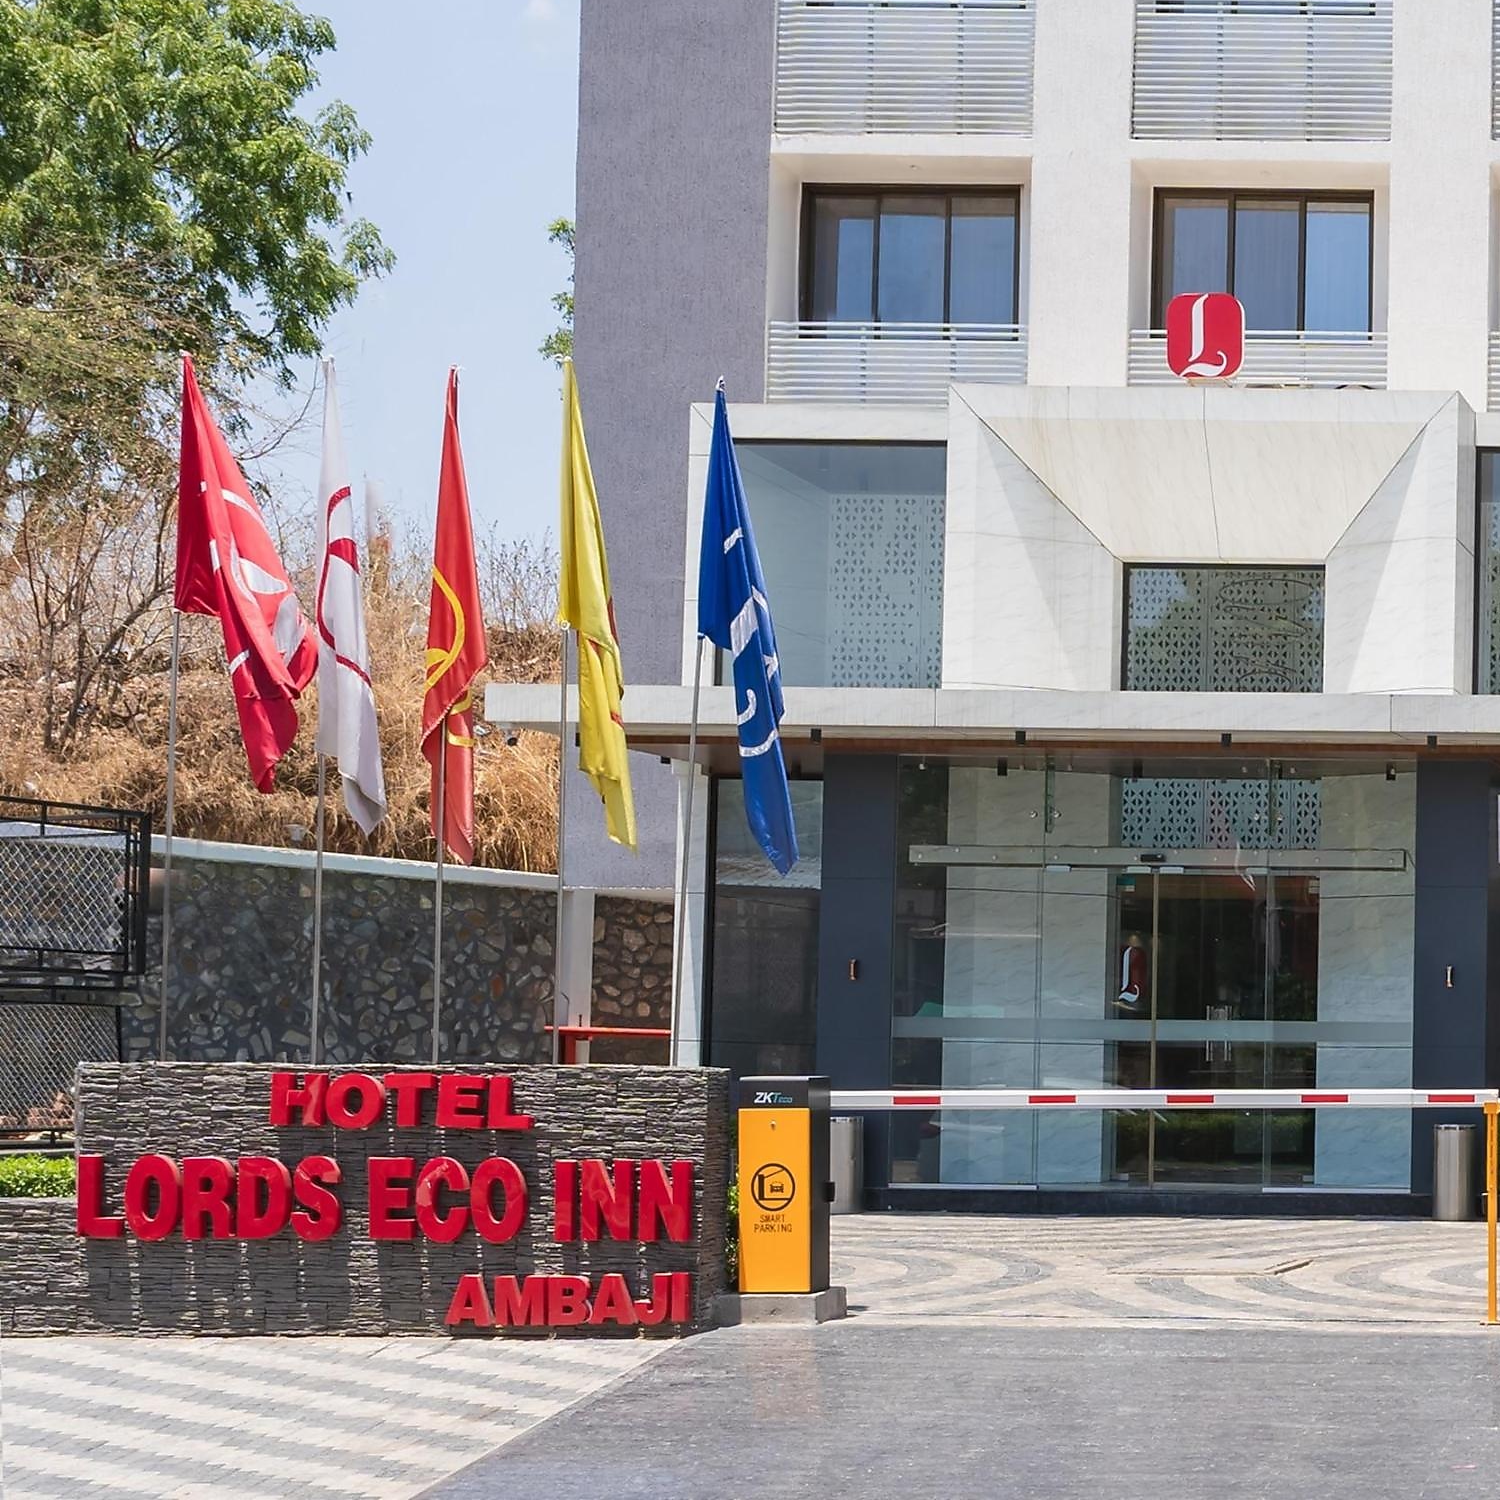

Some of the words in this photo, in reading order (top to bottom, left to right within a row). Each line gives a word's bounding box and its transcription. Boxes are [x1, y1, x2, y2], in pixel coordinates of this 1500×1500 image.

[269, 1072, 535, 1131] HOTEL
[76, 1153, 343, 1242] LORDS
[368, 1156, 528, 1245] ECO
[553, 1158, 694, 1243] INN
[759, 1214, 786, 1223] SMART
[753, 1223, 793, 1234] PARKING
[446, 1271, 692, 1327] AMBAJI
